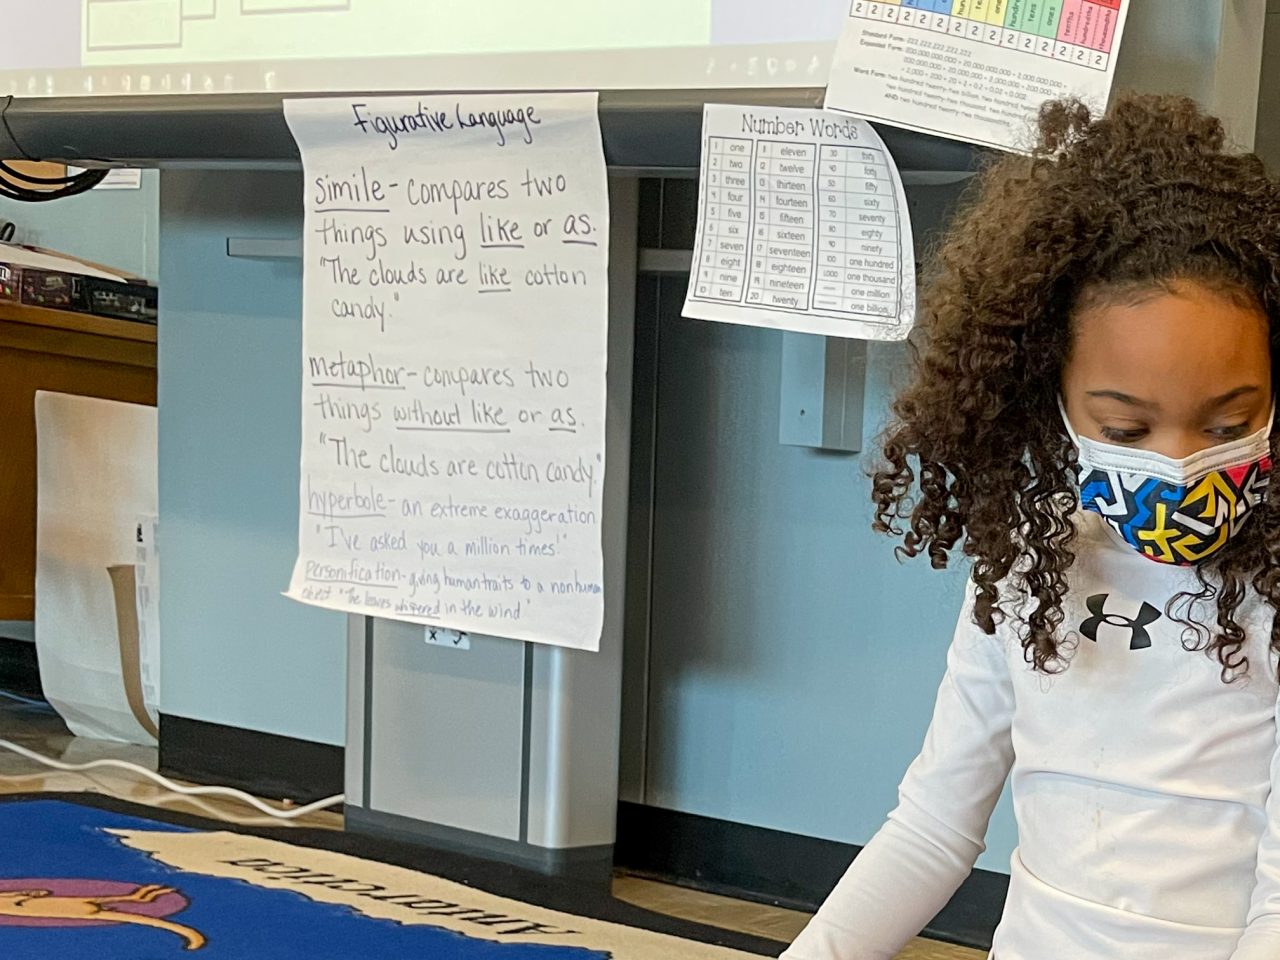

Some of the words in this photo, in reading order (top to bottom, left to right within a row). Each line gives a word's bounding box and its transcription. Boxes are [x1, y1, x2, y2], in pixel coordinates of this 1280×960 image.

[351, 103, 453, 149] Figurative
[456, 103, 541, 147] Language
[742, 113, 804, 136] Number
[810, 118, 858, 140] Words
[729, 144, 744, 152] one
[780, 147, 806, 157] eleven
[729, 160, 743, 168] two
[780, 163, 805, 173] twelve
[725, 176, 745, 186] three
[776, 180, 806, 191] thirteen
[408, 176, 509, 215] compares
[521, 169, 567, 197] two
[727, 191, 744, 202] four
[728, 208, 742, 219] five
[315, 218, 387, 261] things
[404, 222, 466, 260] using
[480, 212, 522, 243] like
[534, 217, 552, 238] or
[720, 242, 744, 251] seven
[769, 246, 811, 258] seventeen
[720, 258, 740, 269] eight
[771, 263, 807, 274] eighteen
[864, 259, 894, 269] hundred
[370, 259, 427, 289] clouds
[436, 265, 468, 286] are
[478, 262, 512, 286] like
[525, 264, 587, 286] cotton
[720, 273, 738, 282] nine
[862, 274, 895, 285] thousand
[769, 279, 804, 289] nineteen
[719, 288, 733, 297] ten
[772, 295, 799, 308] twenty
[424, 364, 515, 395] compares
[526, 361, 569, 388] two
[313, 393, 382, 432] things
[394, 402, 462, 427] without
[472, 400, 509, 427] like
[519, 408, 542, 424] or
[380, 444, 439, 477] clouds
[448, 457, 479, 477] are
[486, 454, 540, 481] cotton
[402, 498, 423, 518] an
[430, 495, 488, 519] extreme
[495, 500, 597, 534] exaggeration
[370, 529, 407, 552] asked
[417, 541, 440, 560] you
[448, 542, 457, 555] a
[465, 536, 511, 557] million
[409, 572, 441, 597] giving
[462, 601, 483, 618] the
